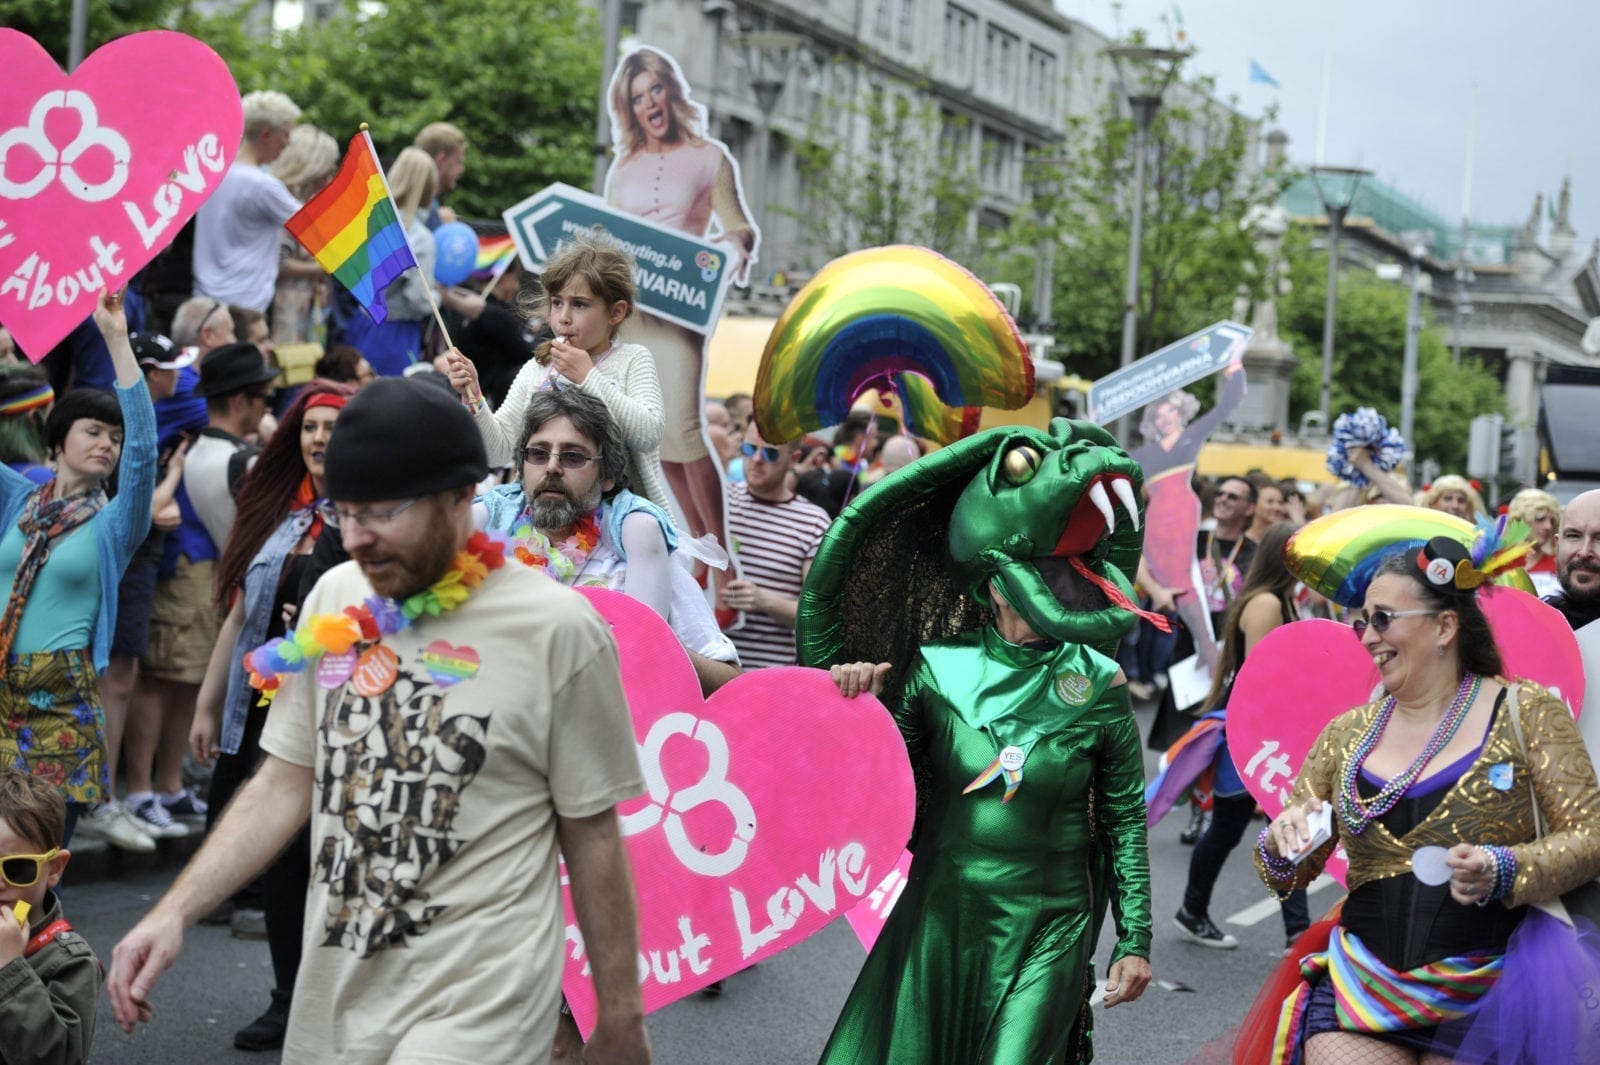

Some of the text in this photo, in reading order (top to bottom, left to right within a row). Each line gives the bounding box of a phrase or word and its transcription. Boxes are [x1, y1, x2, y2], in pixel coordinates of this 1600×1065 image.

[0, 133, 225, 311] About Love
[1004, 751, 1022, 761] YES
[729, 841, 871, 960] Love
